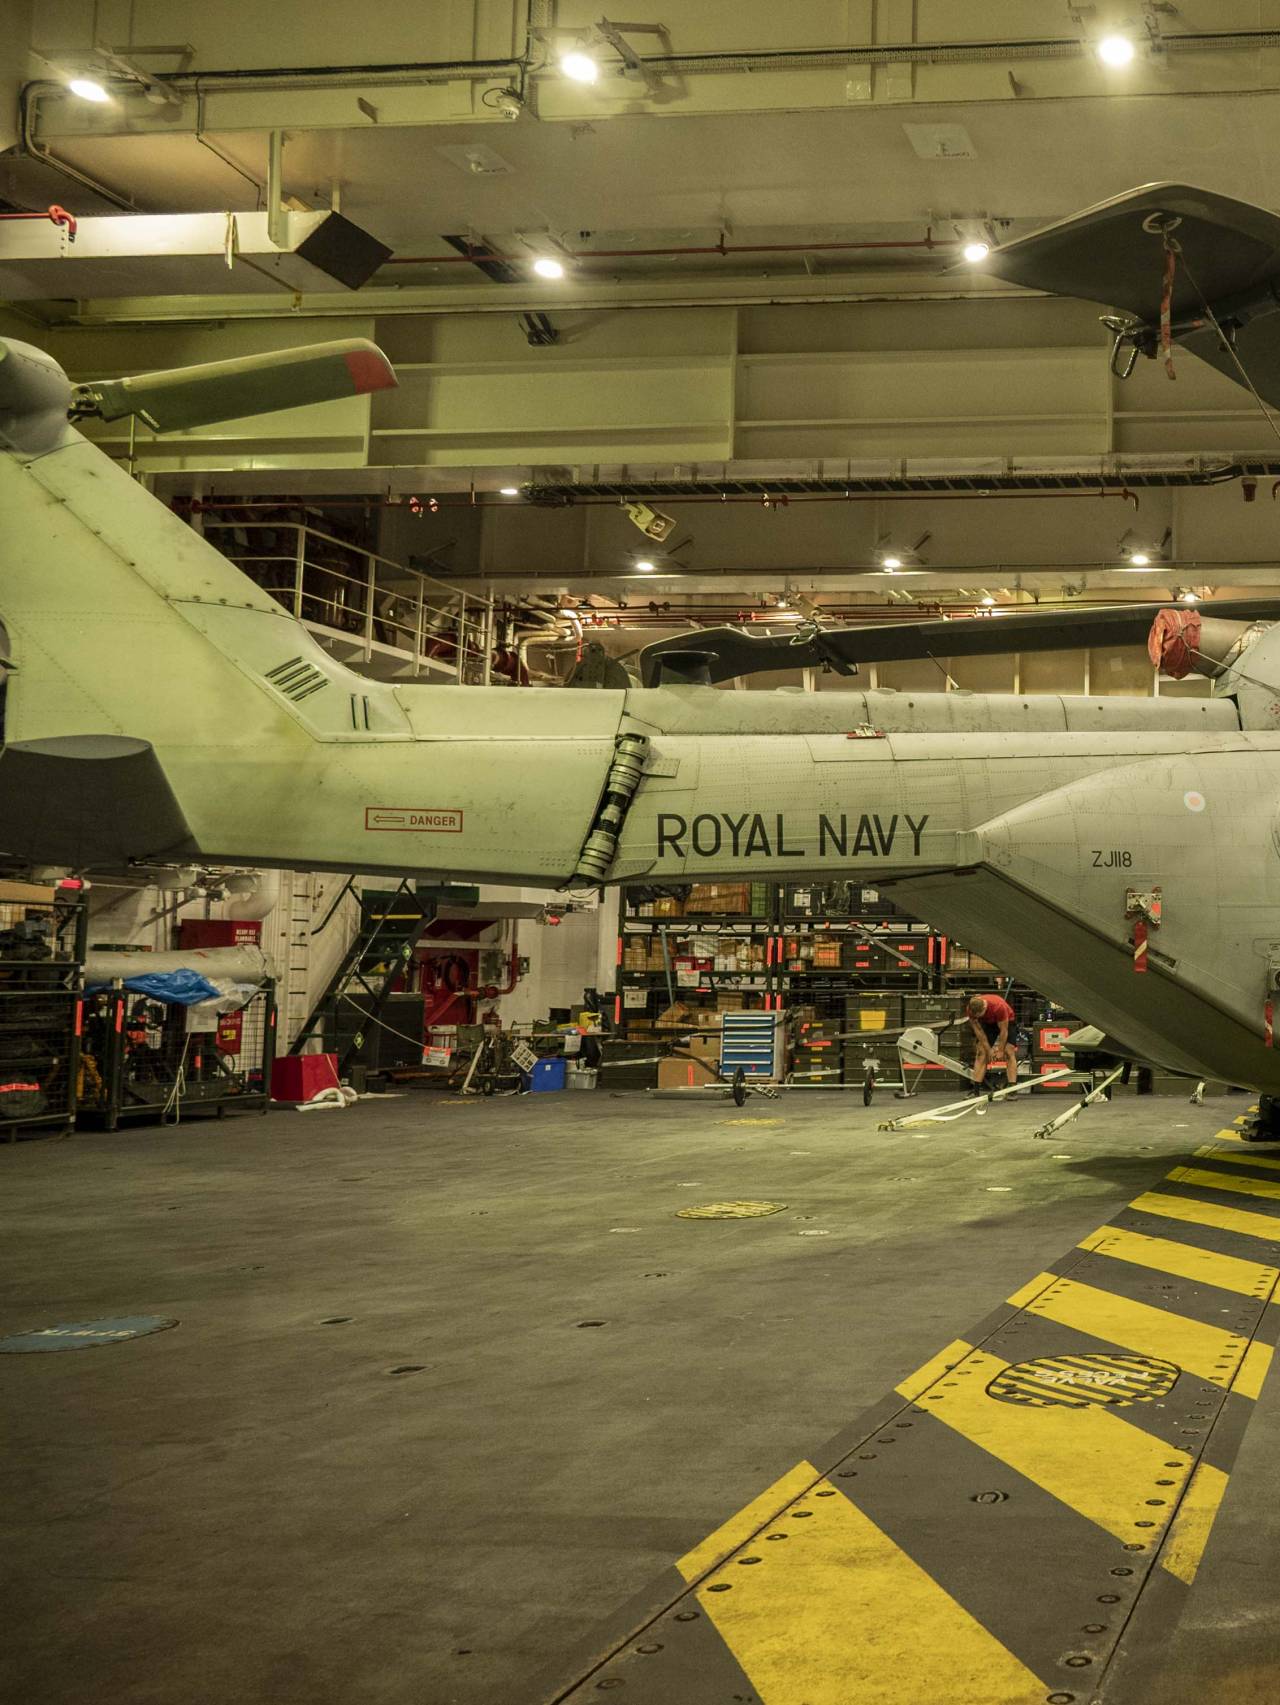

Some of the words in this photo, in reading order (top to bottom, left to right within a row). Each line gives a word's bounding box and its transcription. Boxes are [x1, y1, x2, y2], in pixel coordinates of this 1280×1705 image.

[410, 815, 456, 827] DANGER
[657, 813, 805, 858] ROYAL
[819, 814, 929, 857] NAVY
[1091, 850, 1133, 868] ZJ118
